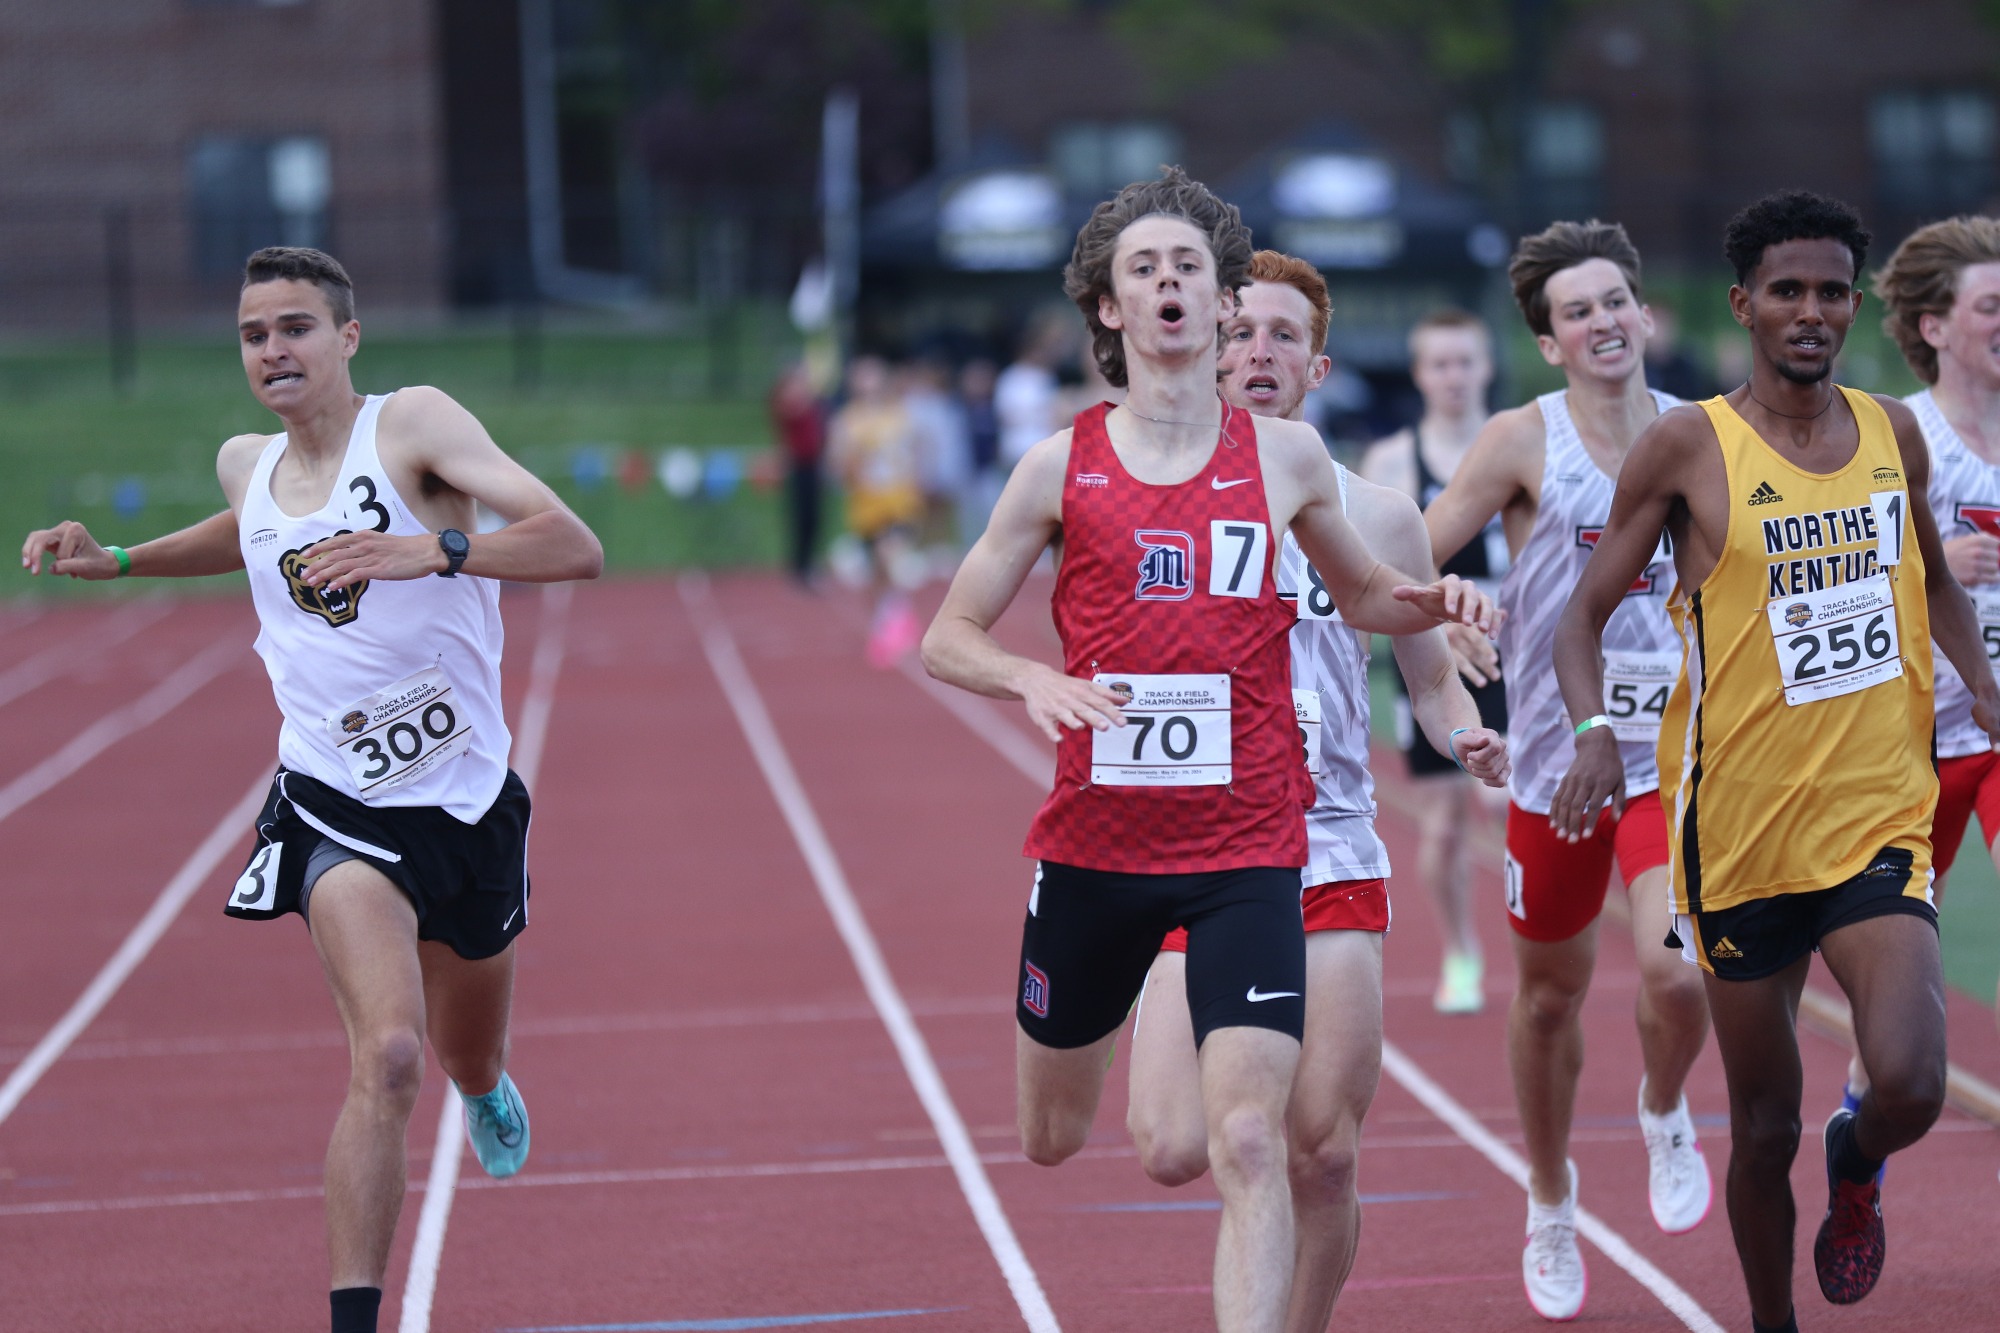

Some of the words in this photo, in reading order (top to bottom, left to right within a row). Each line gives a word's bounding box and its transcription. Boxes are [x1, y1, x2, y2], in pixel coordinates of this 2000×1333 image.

[1076, 476, 1108, 484] HORIZON
[1873, 472, 1899, 480] HORIZON
[348, 476, 390, 534] 3
[1748, 495, 1784, 507] adidas
[250, 533, 278, 545] HORIZON
[1762, 506, 1878, 554] NORTHE
[1886, 495, 1900, 560] 1
[1224, 526, 1255, 592] 7
[1768, 549, 1889, 598] KENTUC
[1307, 561, 1335, 616] 8
[1822, 600, 1848, 611] TRACK
[1856, 592, 1876, 602] FIELD
[1818, 597, 1883, 620] CHAMPIONSHIPS
[1788, 614, 1891, 681] 256
[373, 686, 438, 722] CHAMPIONSHIPS
[375, 698, 400, 713] TRACK
[407, 683, 428, 698] FIELD
[1138, 698, 1216, 706] CHAMPIONSHIPS
[1184, 690, 1209, 698] FIELD
[1608, 684, 1669, 719] 54
[352, 702, 456, 779] 300
[1125, 716, 1198, 760] 70
[238, 848, 272, 904] 3
[1711, 950, 1744, 958] adidas
